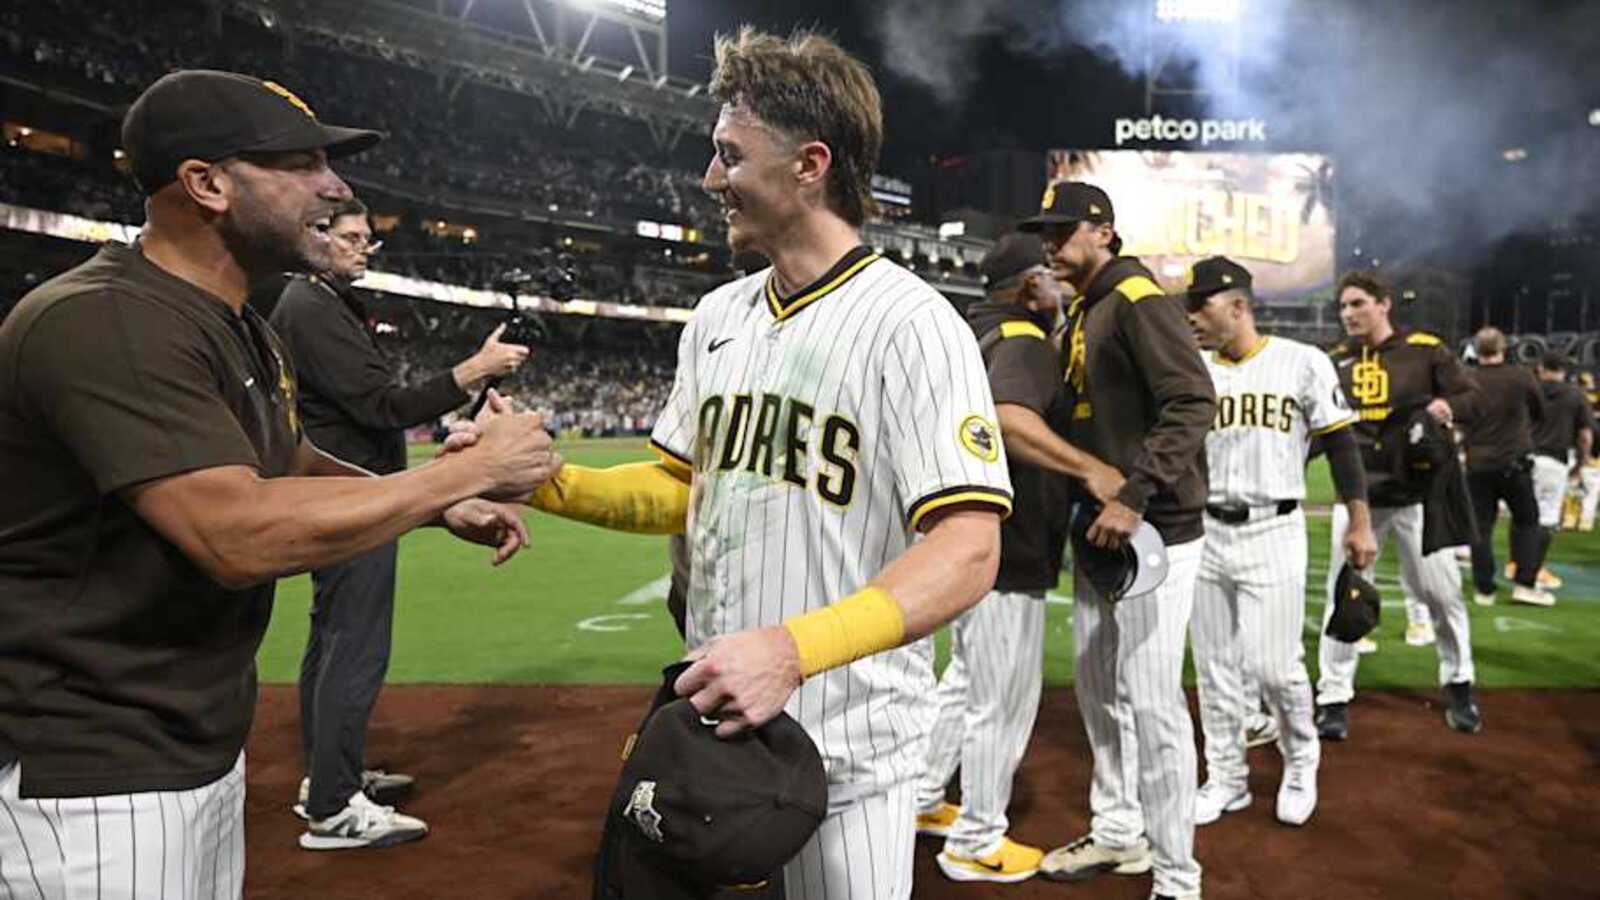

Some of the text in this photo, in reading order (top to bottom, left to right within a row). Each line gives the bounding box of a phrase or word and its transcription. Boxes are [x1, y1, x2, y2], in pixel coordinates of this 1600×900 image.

[1115, 114, 1265, 145] petco park
[1211, 393, 1294, 433] DRES
